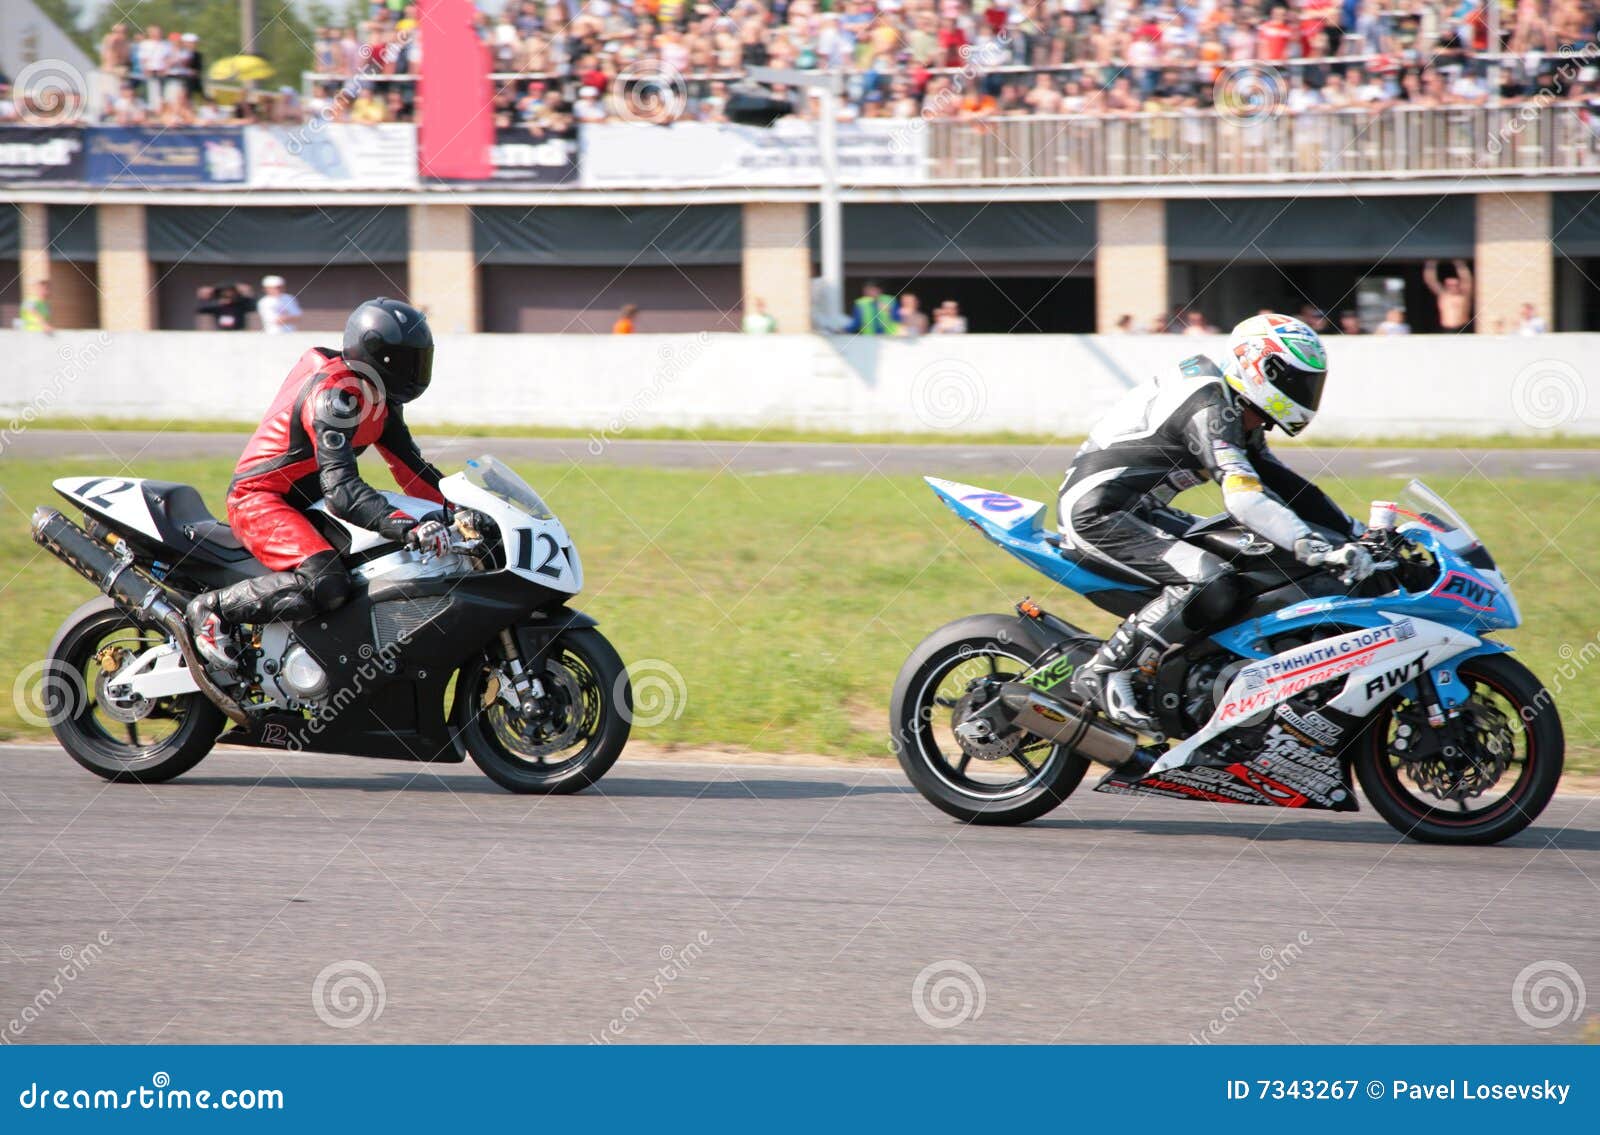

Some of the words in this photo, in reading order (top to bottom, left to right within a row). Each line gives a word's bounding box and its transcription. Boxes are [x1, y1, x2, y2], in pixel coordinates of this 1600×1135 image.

[73, 478, 136, 509] 12
[511, 527, 562, 580] 12
[1441, 575, 1498, 607] RWT
[1264, 645, 1337, 678] ТРИНИТИ
[1366, 651, 1429, 701] RWT
[1219, 686, 1273, 721] RWT
[261, 722, 288, 746] 12
[1159, 773, 1217, 793] ТРИНИТИ
[1218, 787, 1264, 805] СПОРТ
